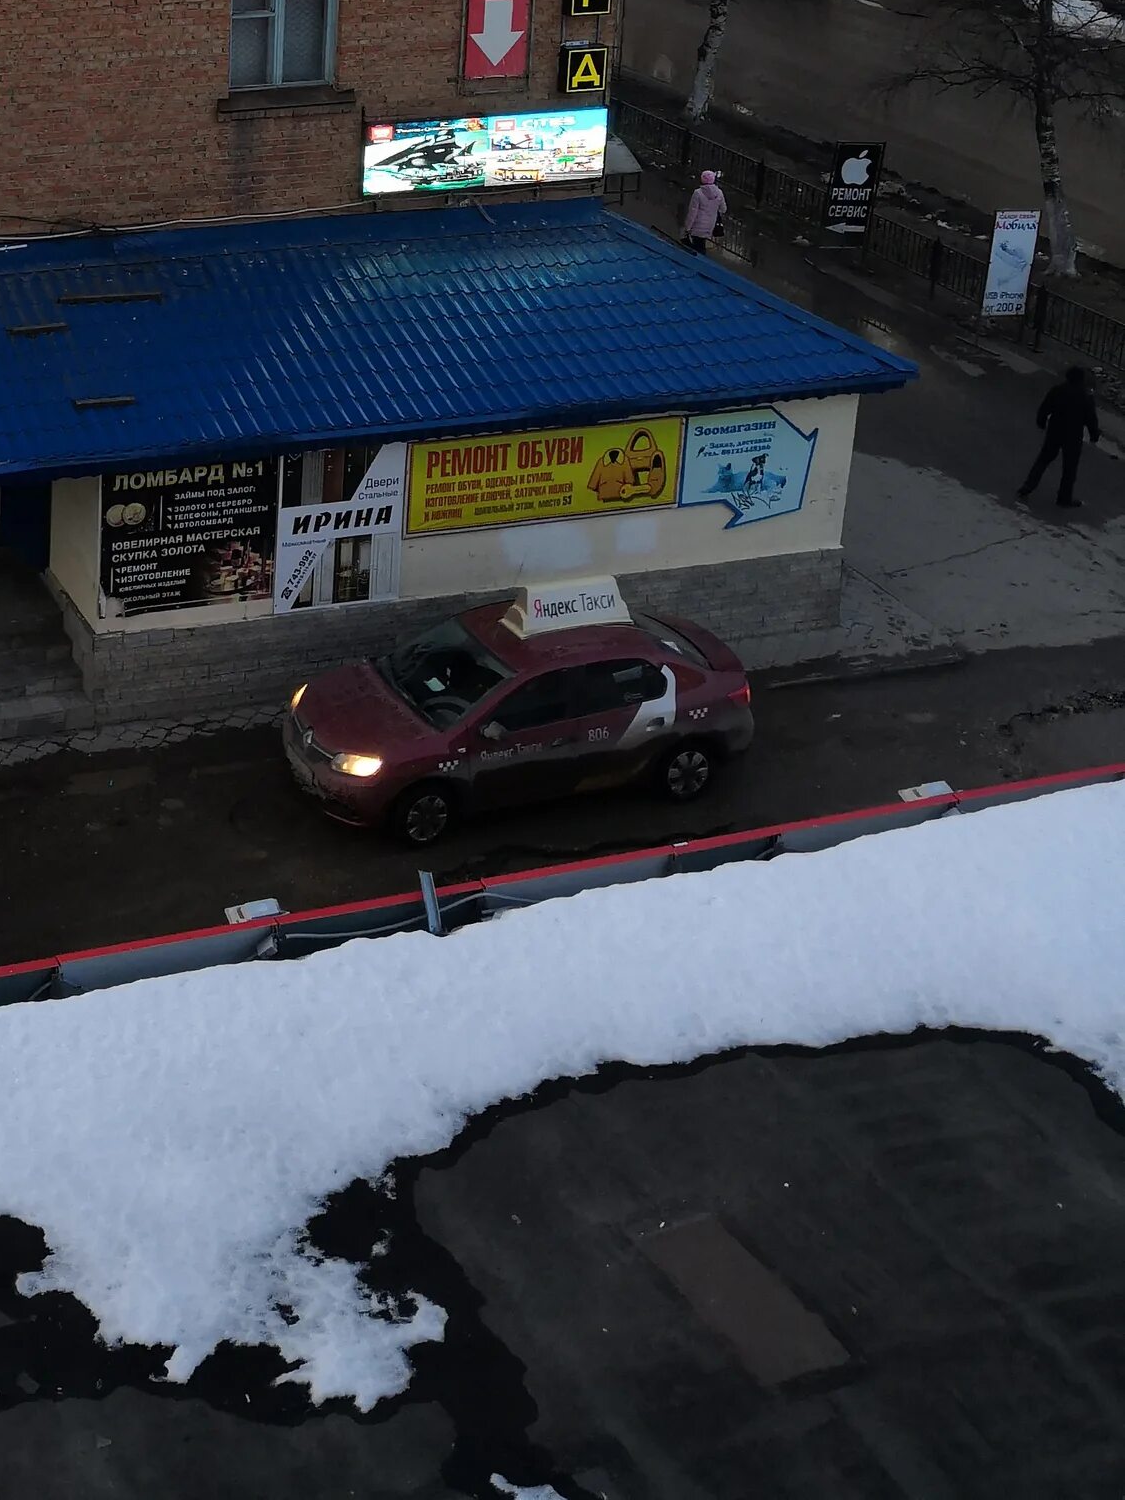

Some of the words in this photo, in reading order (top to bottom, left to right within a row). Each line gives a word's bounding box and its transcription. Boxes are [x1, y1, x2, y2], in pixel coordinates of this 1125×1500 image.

[831, 187, 872, 201] РЕМОНТ
[828, 205, 868, 218] СЕРВИС
[995, 303, 1013, 313] 200
[694, 420, 777, 437] Зоомагазин
[426, 443, 512, 479] РЕМОНТ
[516, 436, 584, 470] ОБУВИ
[113, 463, 225, 492] ЛОМБАРД
[364, 476, 400, 490] Двери
[425, 482, 456, 494] РЕМОНТ
[457, 479, 483, 492] ОБУВИ,
[485, 476, 518, 488] ОДЕЖДЫ
[174, 490, 205, 501] ЗАЙМЫ
[207, 488, 225, 498] ПОД
[227, 485, 256, 496] ЗАЛОГ:
[358, 489, 399, 501] Стальные
[425, 493, 479, 508] ИЗГОТОВЛЕНИЕ
[514, 484, 547, 499] ЗАТОЧКА
[174, 503, 207, 513] ЗОЛОТО
[216, 498, 253, 508] СЕРЕБРО
[174, 510, 221, 521] ТЕЛЕФОНЫ,
[223, 504, 269, 516] ПЛАНШЕТЫ
[173, 516, 234, 530] АВТОЛОМБАРД
[291, 505, 393, 536] ИРИНА
[111, 534, 183, 551] ЮВЕЛИРНАЯ
[186, 526, 261, 542] МАСТЕРСКАЯ
[111, 549, 158, 564] СКУПКА
[161, 544, 206, 558] ЗОЛОТА
[121, 562, 159, 574] РЕМОНТ
[287, 549, 314, 586] 743-992
[121, 568, 192, 584] ИЗГОТОВЛЕНИЕ
[123, 592, 161, 604] ОКОЛЬНЫЙ
[161, 590, 181, 599] ЭТАЖ
[533, 599, 579, 619] Яндекс
[579, 592, 616, 612] Такси
[588, 726, 610, 742] 806
